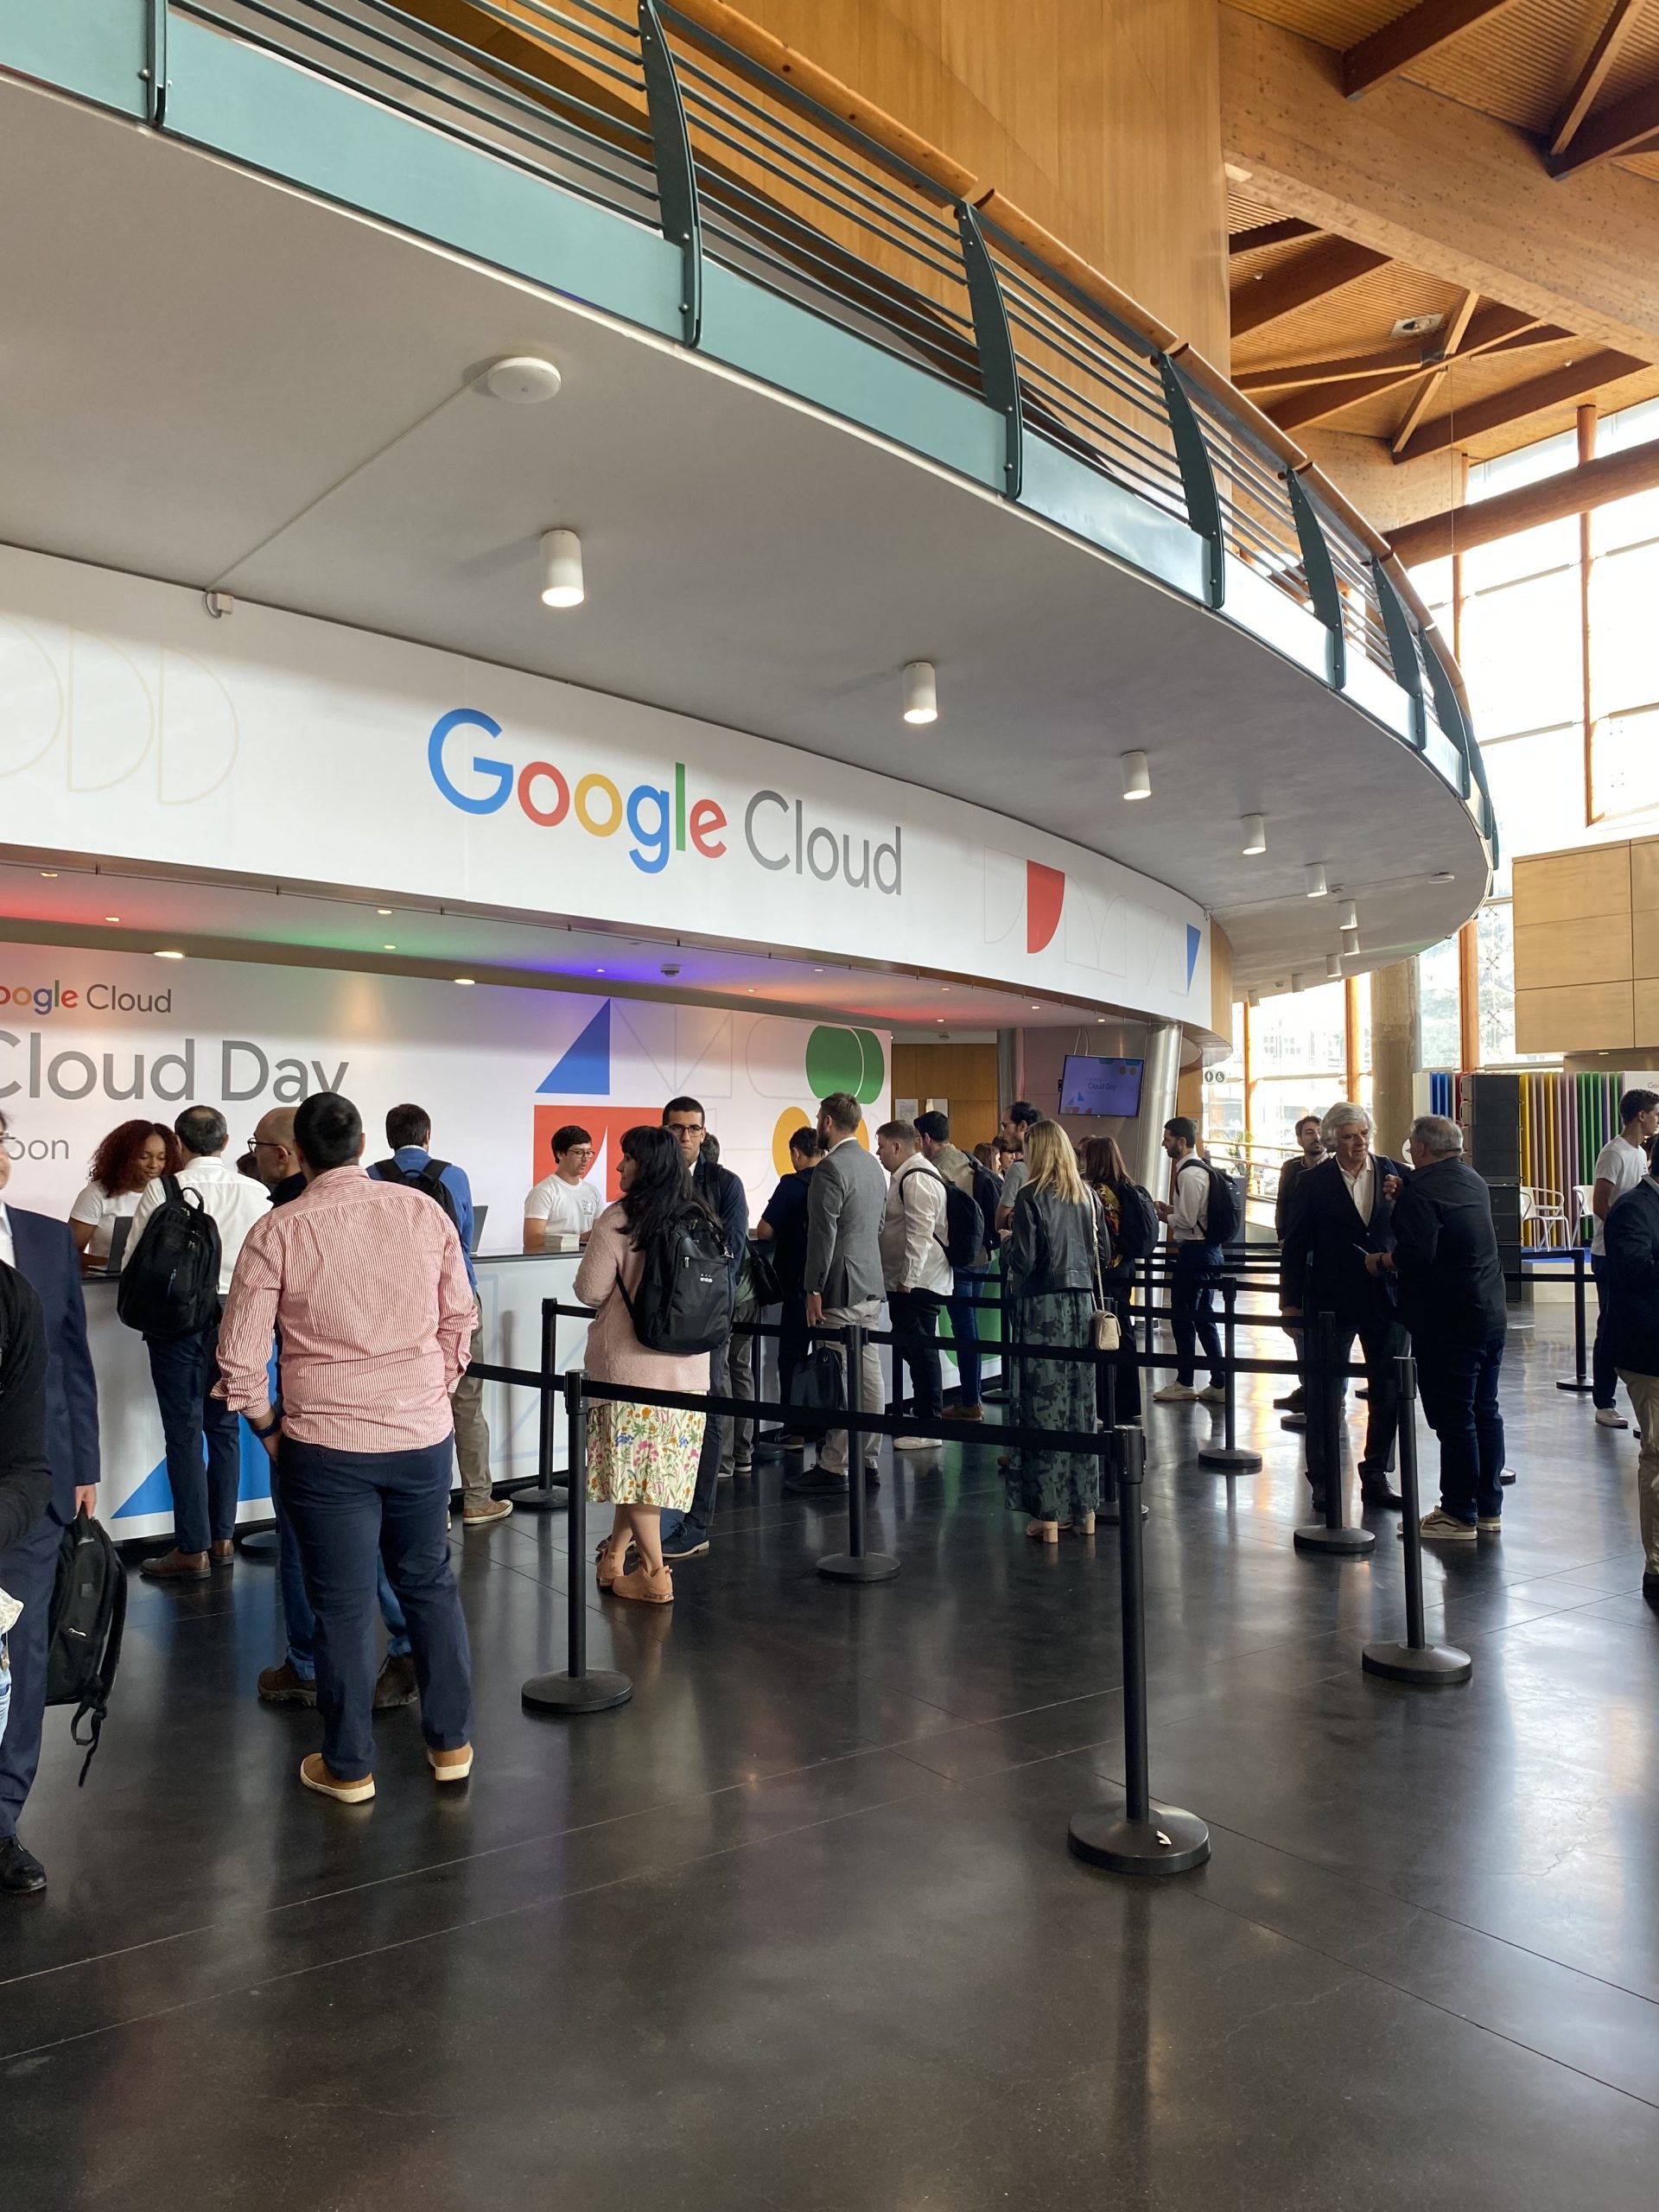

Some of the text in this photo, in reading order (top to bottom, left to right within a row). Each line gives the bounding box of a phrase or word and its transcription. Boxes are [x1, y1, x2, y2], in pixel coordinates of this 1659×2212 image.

[428, 708, 901, 895] Google Cloud
[86, 983, 172, 1013] Cloud
[221, 1039, 350, 1103] Day
